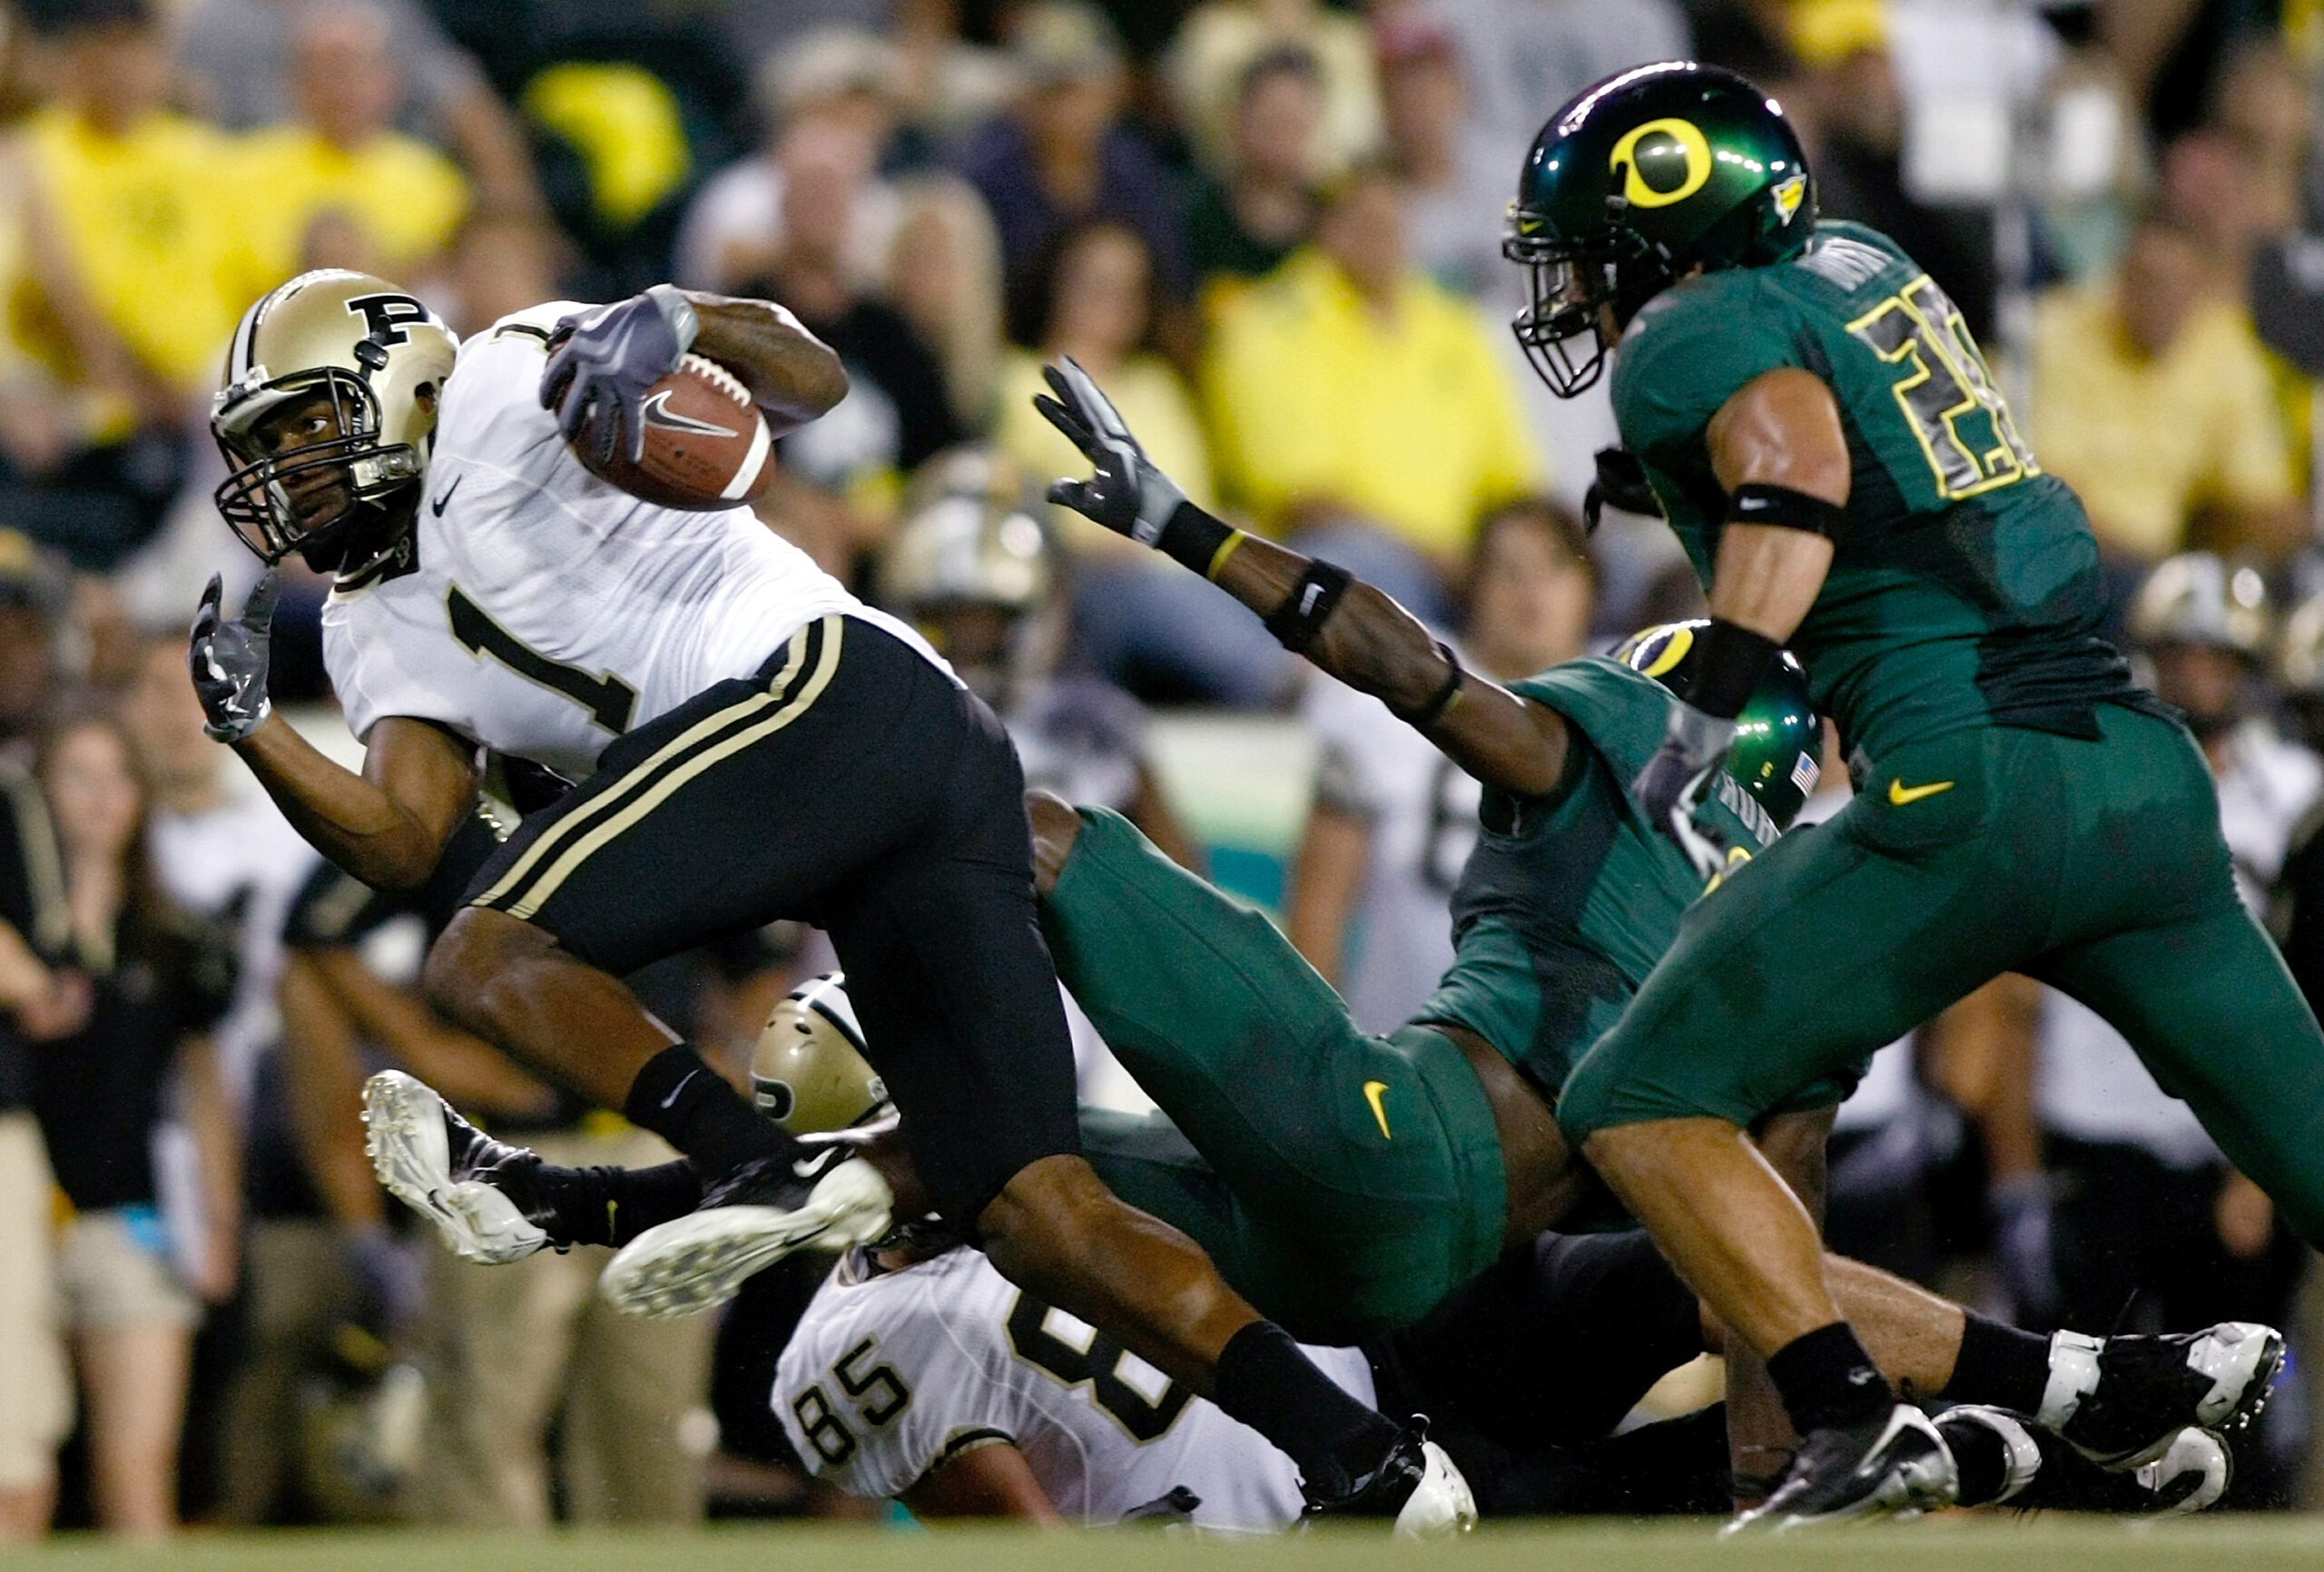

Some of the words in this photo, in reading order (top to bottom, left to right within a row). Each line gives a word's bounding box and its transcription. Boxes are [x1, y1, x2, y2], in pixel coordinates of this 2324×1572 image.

[1610, 118, 1712, 209] O
[344, 292, 434, 349] P
[444, 579, 641, 738] 1
[793, 1332, 911, 1467] 85
